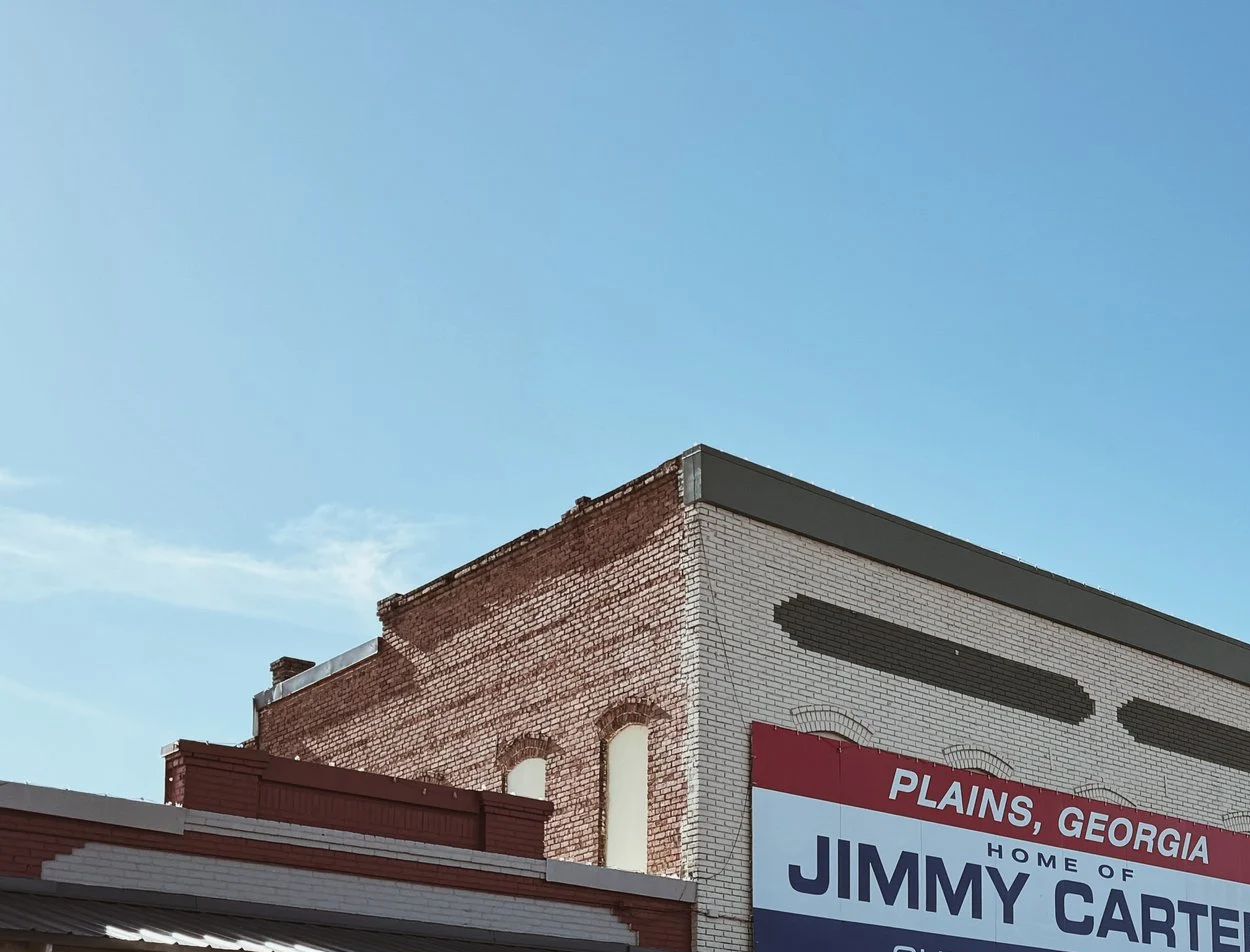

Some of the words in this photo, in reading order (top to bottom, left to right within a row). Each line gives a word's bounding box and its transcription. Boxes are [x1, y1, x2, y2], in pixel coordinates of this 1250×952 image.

[889, 768, 1042, 834] PLAINS,
[1058, 806, 1209, 864] GEORGIA
[789, 835, 1029, 924] JIMMY
[987, 842, 1078, 873] HOME
[1098, 864, 1136, 883] OF
